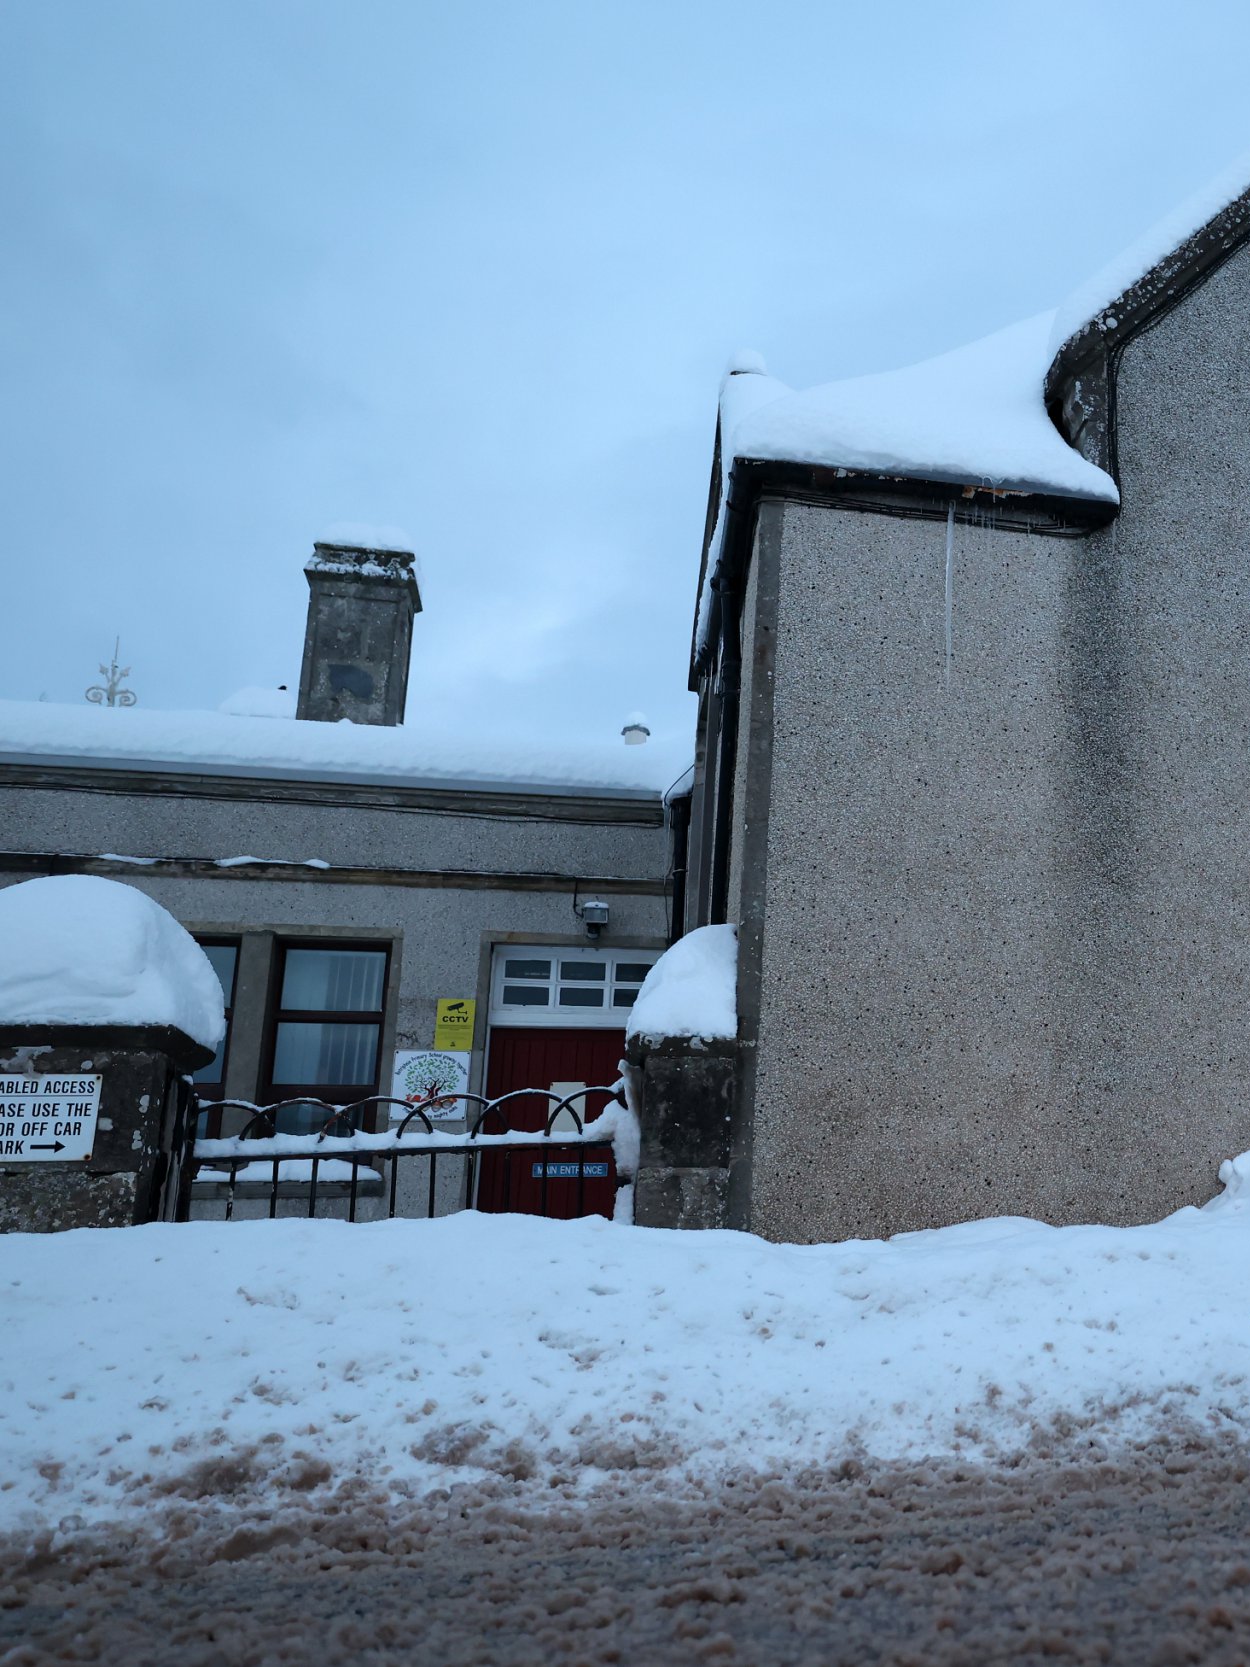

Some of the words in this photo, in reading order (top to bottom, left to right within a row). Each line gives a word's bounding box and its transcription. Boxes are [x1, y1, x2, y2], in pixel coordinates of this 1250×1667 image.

[0, 1080, 39, 1094] ABLED
[44, 1080, 95, 1094] ACCESS
[32, 1103, 60, 1117] USE
[67, 1103, 92, 1117] THE
[21, 1122, 48, 1137] OFF
[54, 1122, 82, 1136] CAR
